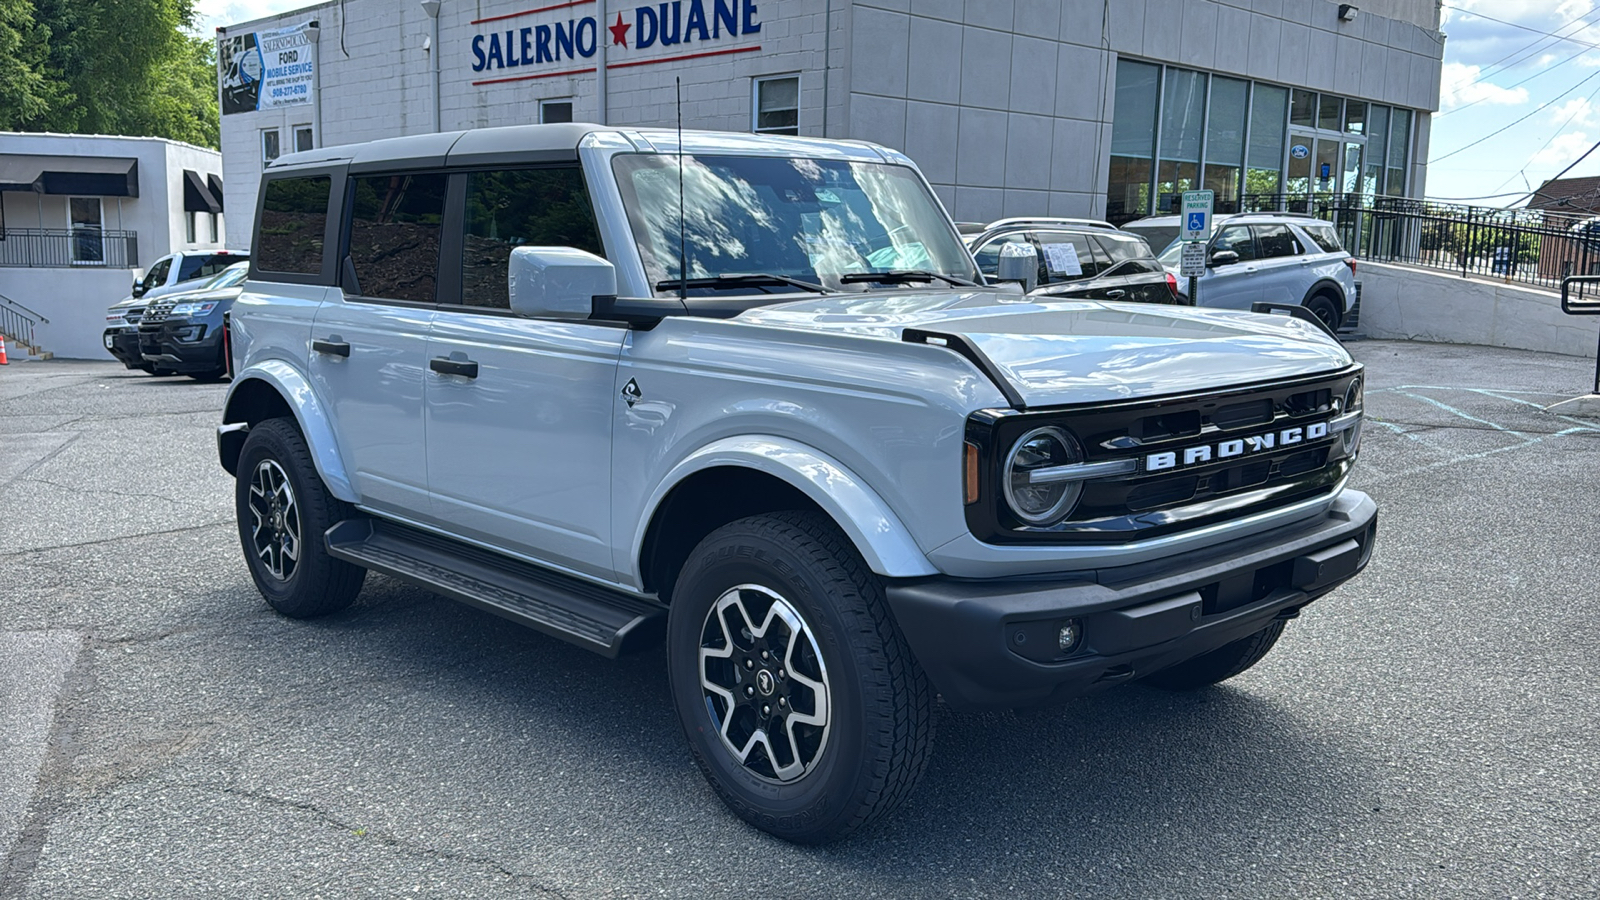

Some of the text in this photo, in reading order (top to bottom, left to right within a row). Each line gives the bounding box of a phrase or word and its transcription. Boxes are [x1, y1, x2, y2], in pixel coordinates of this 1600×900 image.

[472, 0, 762, 72] SALERNO DUANE
[279, 50, 298, 65] FORD
[267, 62, 312, 78] MOBILE SERVICE
[1185, 193, 1212, 202] RESERVED
[1187, 201, 1209, 209] PARKING
[1146, 422, 1327, 472] BRONCO
